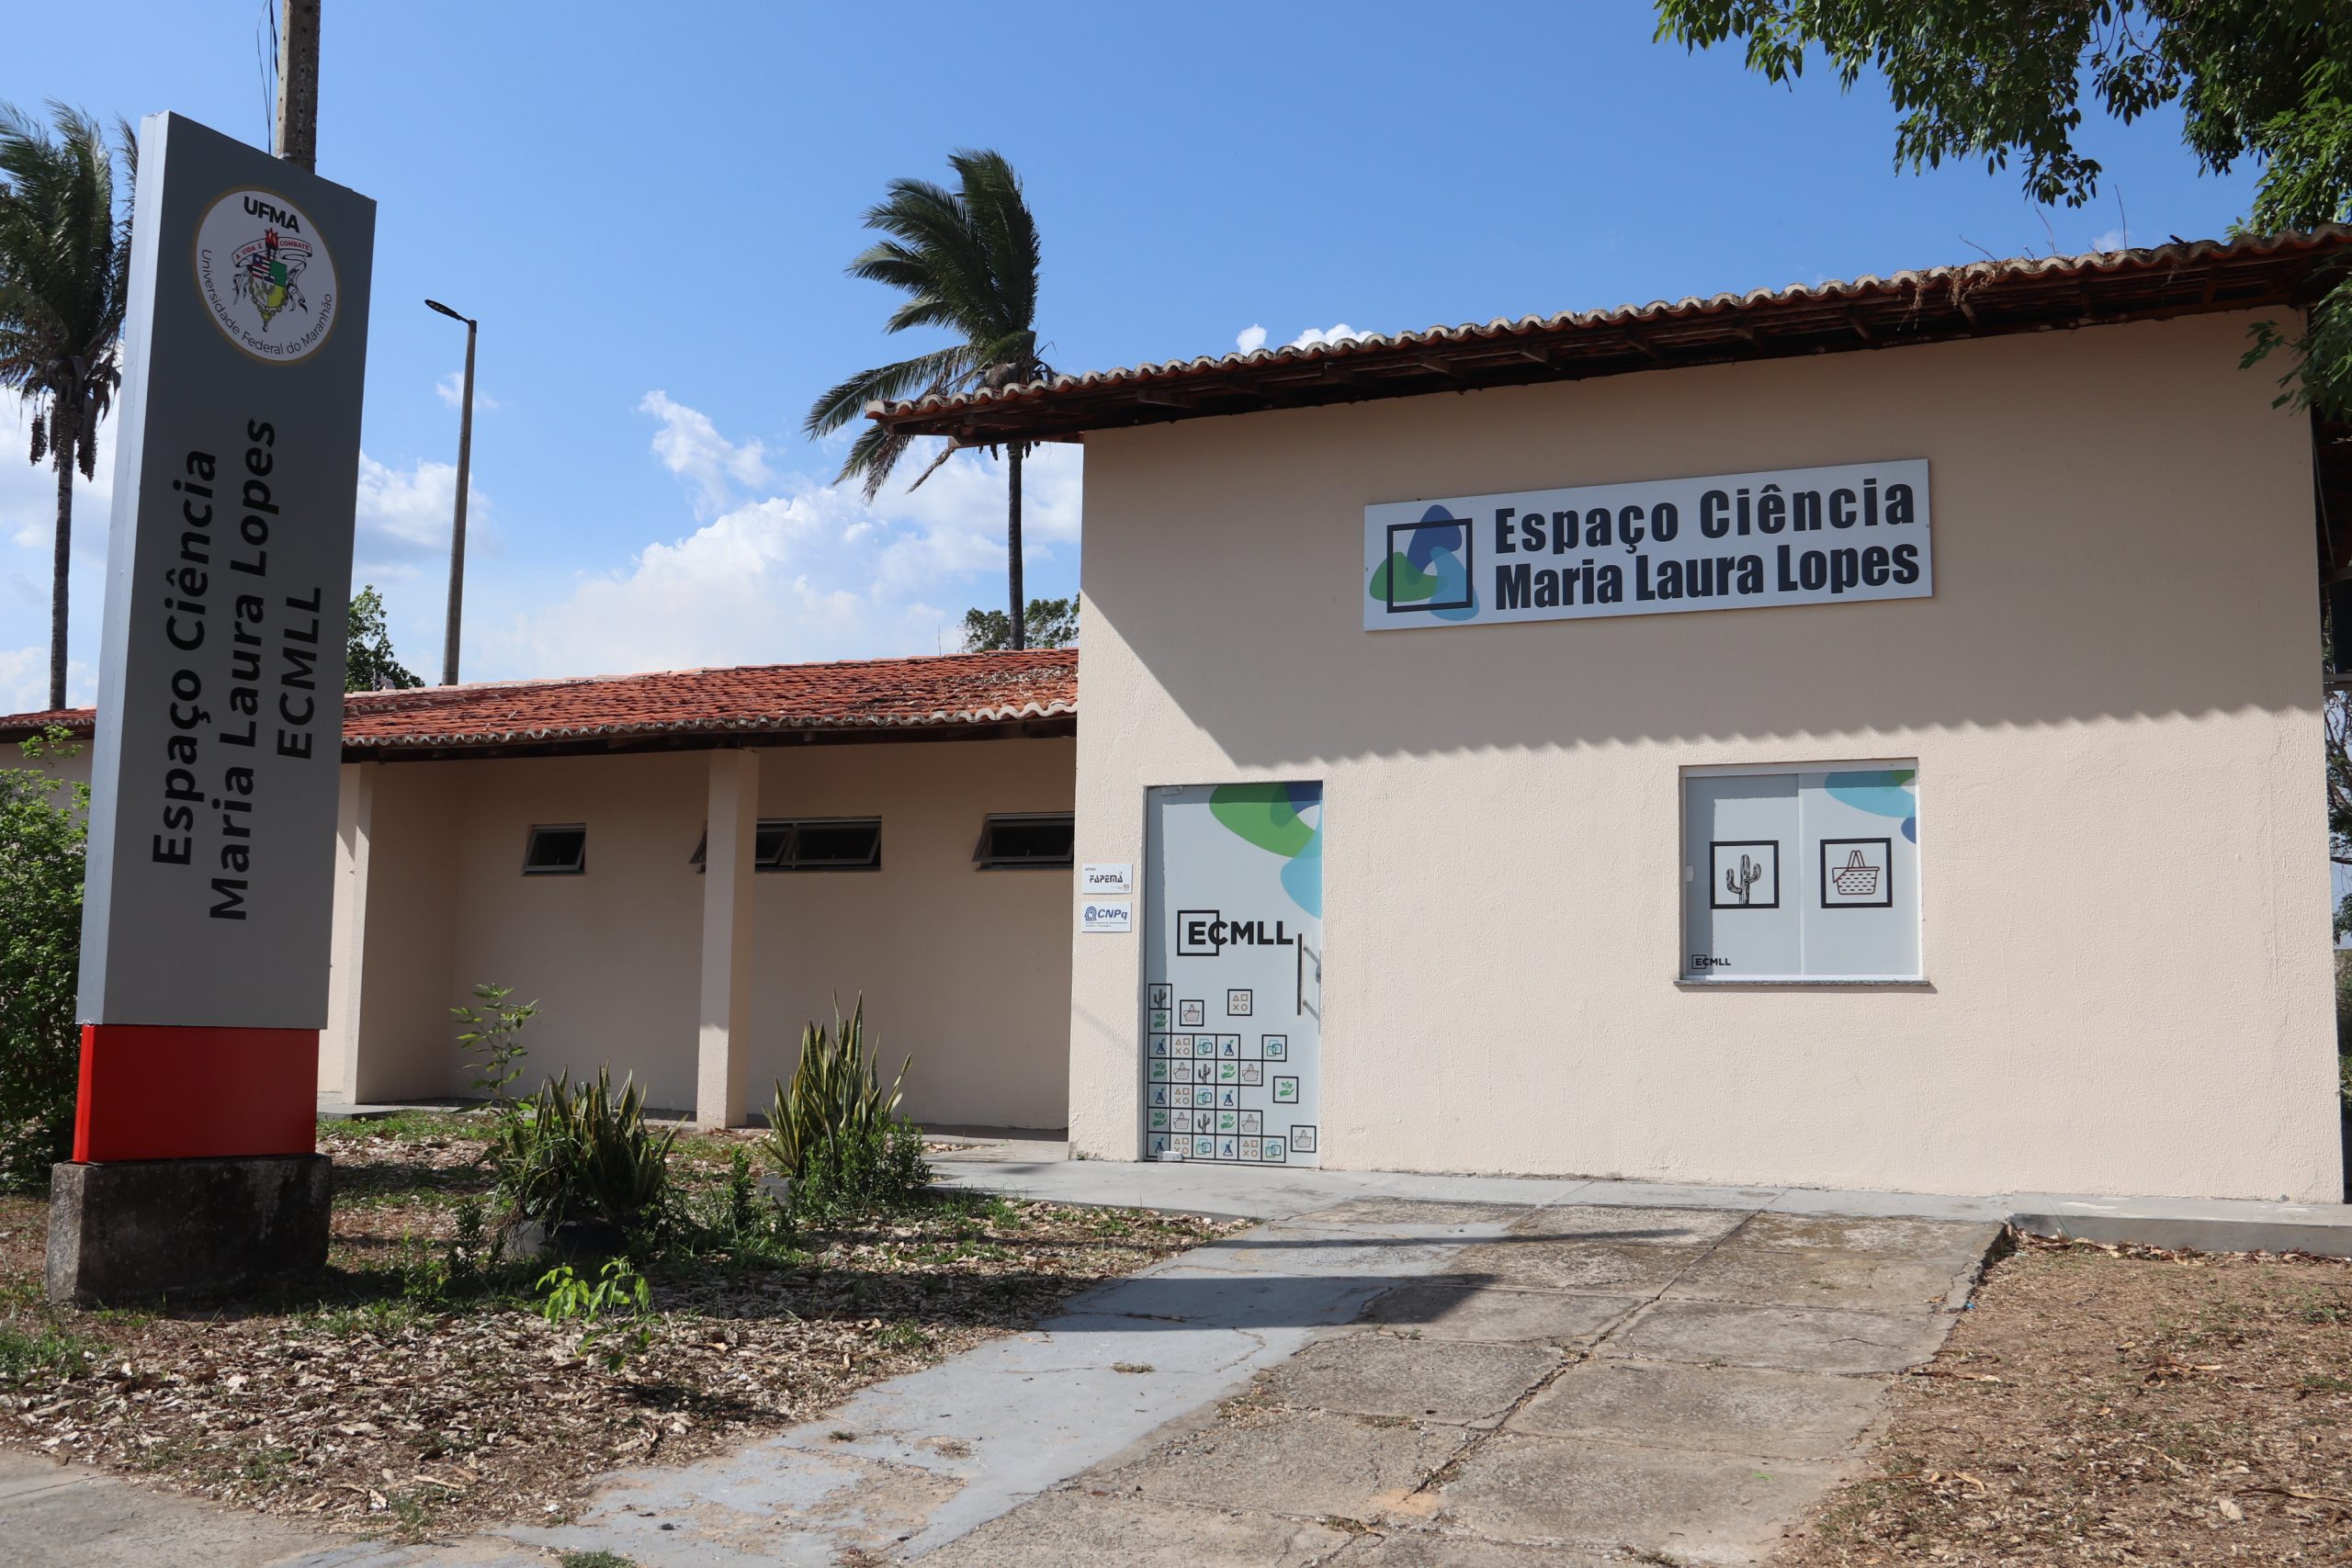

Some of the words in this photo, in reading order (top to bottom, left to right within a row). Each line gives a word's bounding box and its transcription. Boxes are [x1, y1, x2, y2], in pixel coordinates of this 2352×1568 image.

[242, 245, 256, 255] VIDA
[279, 241, 310, 251] COMBATE
[243, 196, 300, 233] UFMA
[201, 249, 241, 335] Universidade
[242, 332, 284, 355] Federal
[287, 340, 301, 354] do
[300, 294, 333, 347] Maranhão
[230, 419, 279, 577] Lopes
[1495, 502, 1679, 555] Espaço
[1700, 478, 1915, 539] Ciência
[165, 450, 216, 652] Ciência
[1495, 558, 1623, 611] Maria
[1635, 547, 1764, 602] Laura
[1777, 542, 1920, 594] Lopes
[219, 596, 265, 748] Laura
[277, 586, 322, 760] ECMLL
[152, 669, 210, 866] Espaço
[209, 766, 254, 920] Maria
[1097, 908, 1128, 920] CNPq
[1188, 920, 1294, 946] ECMLL
[1695, 957, 1731, 966] ECMLL
